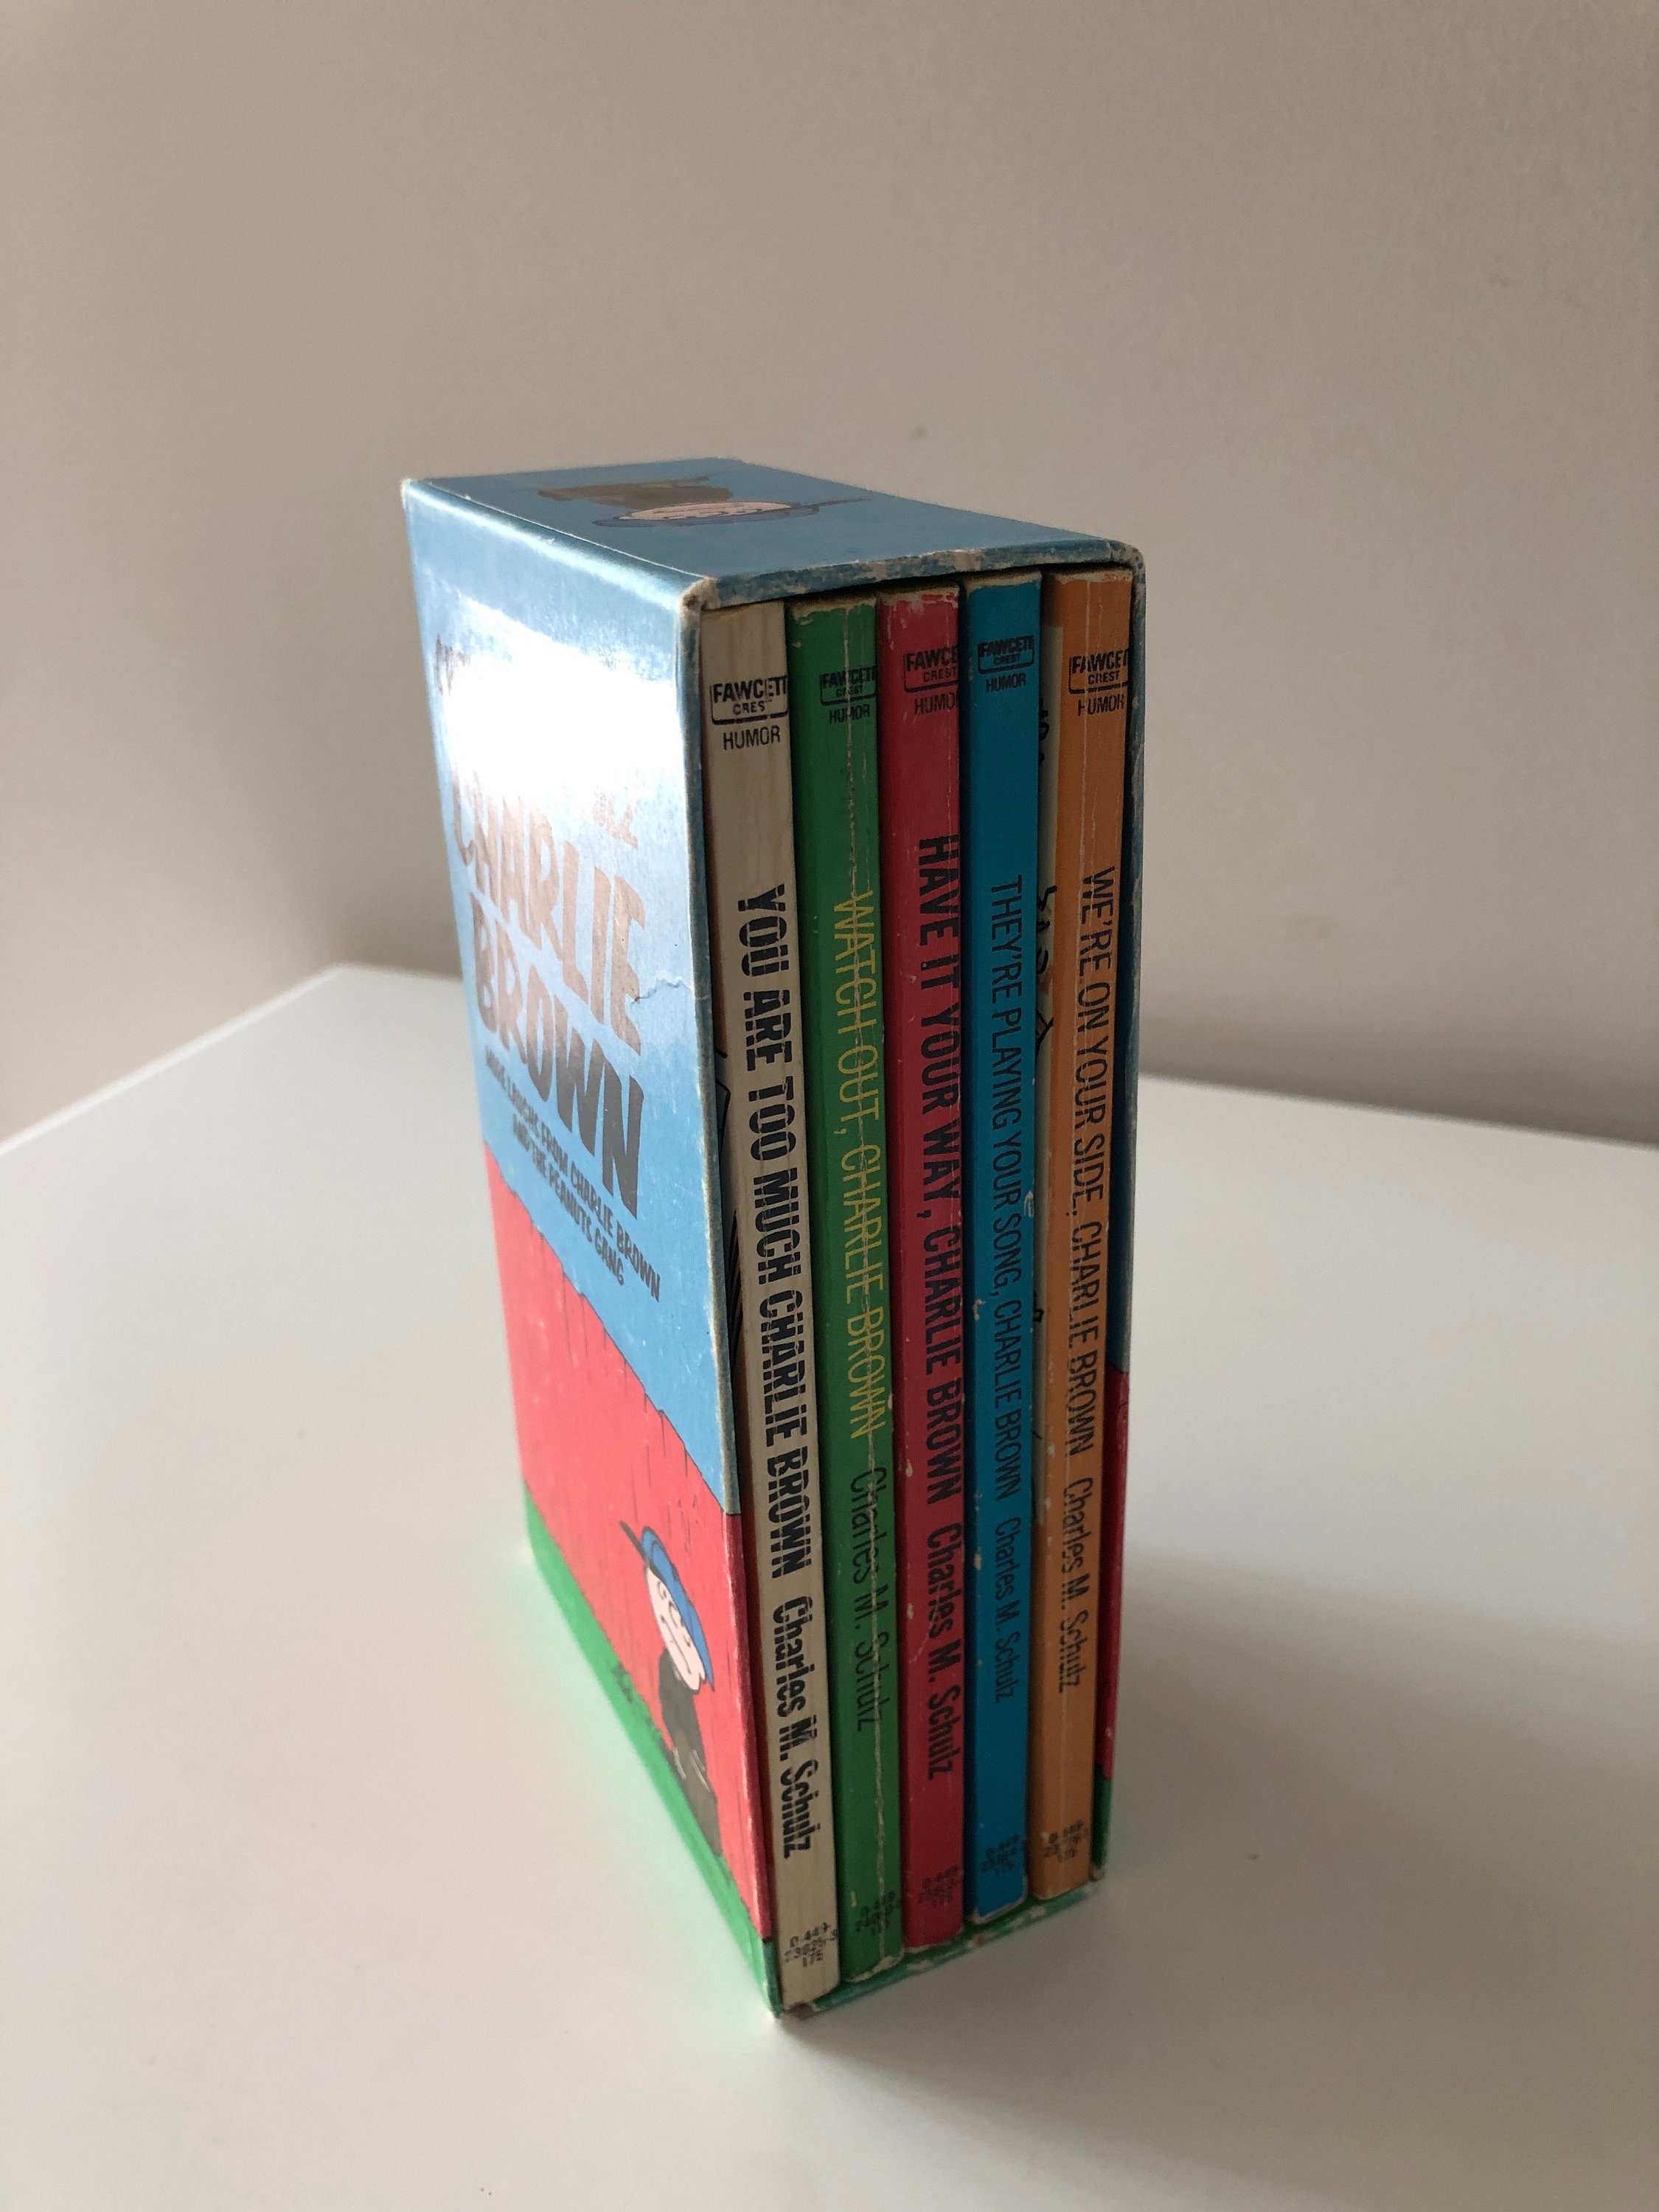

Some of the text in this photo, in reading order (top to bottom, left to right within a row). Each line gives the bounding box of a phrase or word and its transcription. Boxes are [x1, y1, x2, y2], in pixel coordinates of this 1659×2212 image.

[907, 645, 959, 672] FAWCE
[923, 667, 957, 682] CREST
[978, 635, 1034, 658] FAWCETT
[986, 672, 1026, 692] HUMOR
[1088, 670, 1120, 685] CREST
[723, 726, 781, 751] HUMOR
[830, 704, 870, 724] HUMOR
[914, 692, 959, 714] HUMO
[1078, 694, 1124, 717] HUMOR
[451, 763, 645, 1056] CHARLIE
[1079, 866, 1116, 978] WE'RE
[1077, 981, 1111, 1034] ON
[470, 892, 645, 1219] BROWN
[1074, 1034, 1110, 1128] YOUR
[530, 1137, 548, 1181] THE
[549, 1163, 592, 1243] PEANUTS
[594, 1227, 625, 1287] GANG
[541, 1121, 568, 1178] FROM
[571, 1161, 613, 1239] CHARLIE
[616, 1219, 661, 1304] BROWN
[834, 889, 890, 1733] WATCH OUT, CHARLIE BROWN Charles M. Schulz
[917, 834, 964, 1781] HAVE IT YOUR WAY, CHARLIE BROWN Charles M. Schulz
[990, 874, 1023, 1704] THEY'RE PLAYING YOUR SONG, CHARLIE BROWN Charles M. Schulz
[1067, 1220, 1105, 1350] CHARLIE
[737, 883, 821, 1860] YOU ARE TOO MUCH CHARLIE BROWN Charles M. Schulz
[1065, 1349, 1099, 1457] BROWN
[1061, 1475, 1094, 1582] Charles
[1060, 1571, 1091, 1610] M.
[1057, 1608, 1091, 1694] Schulz
